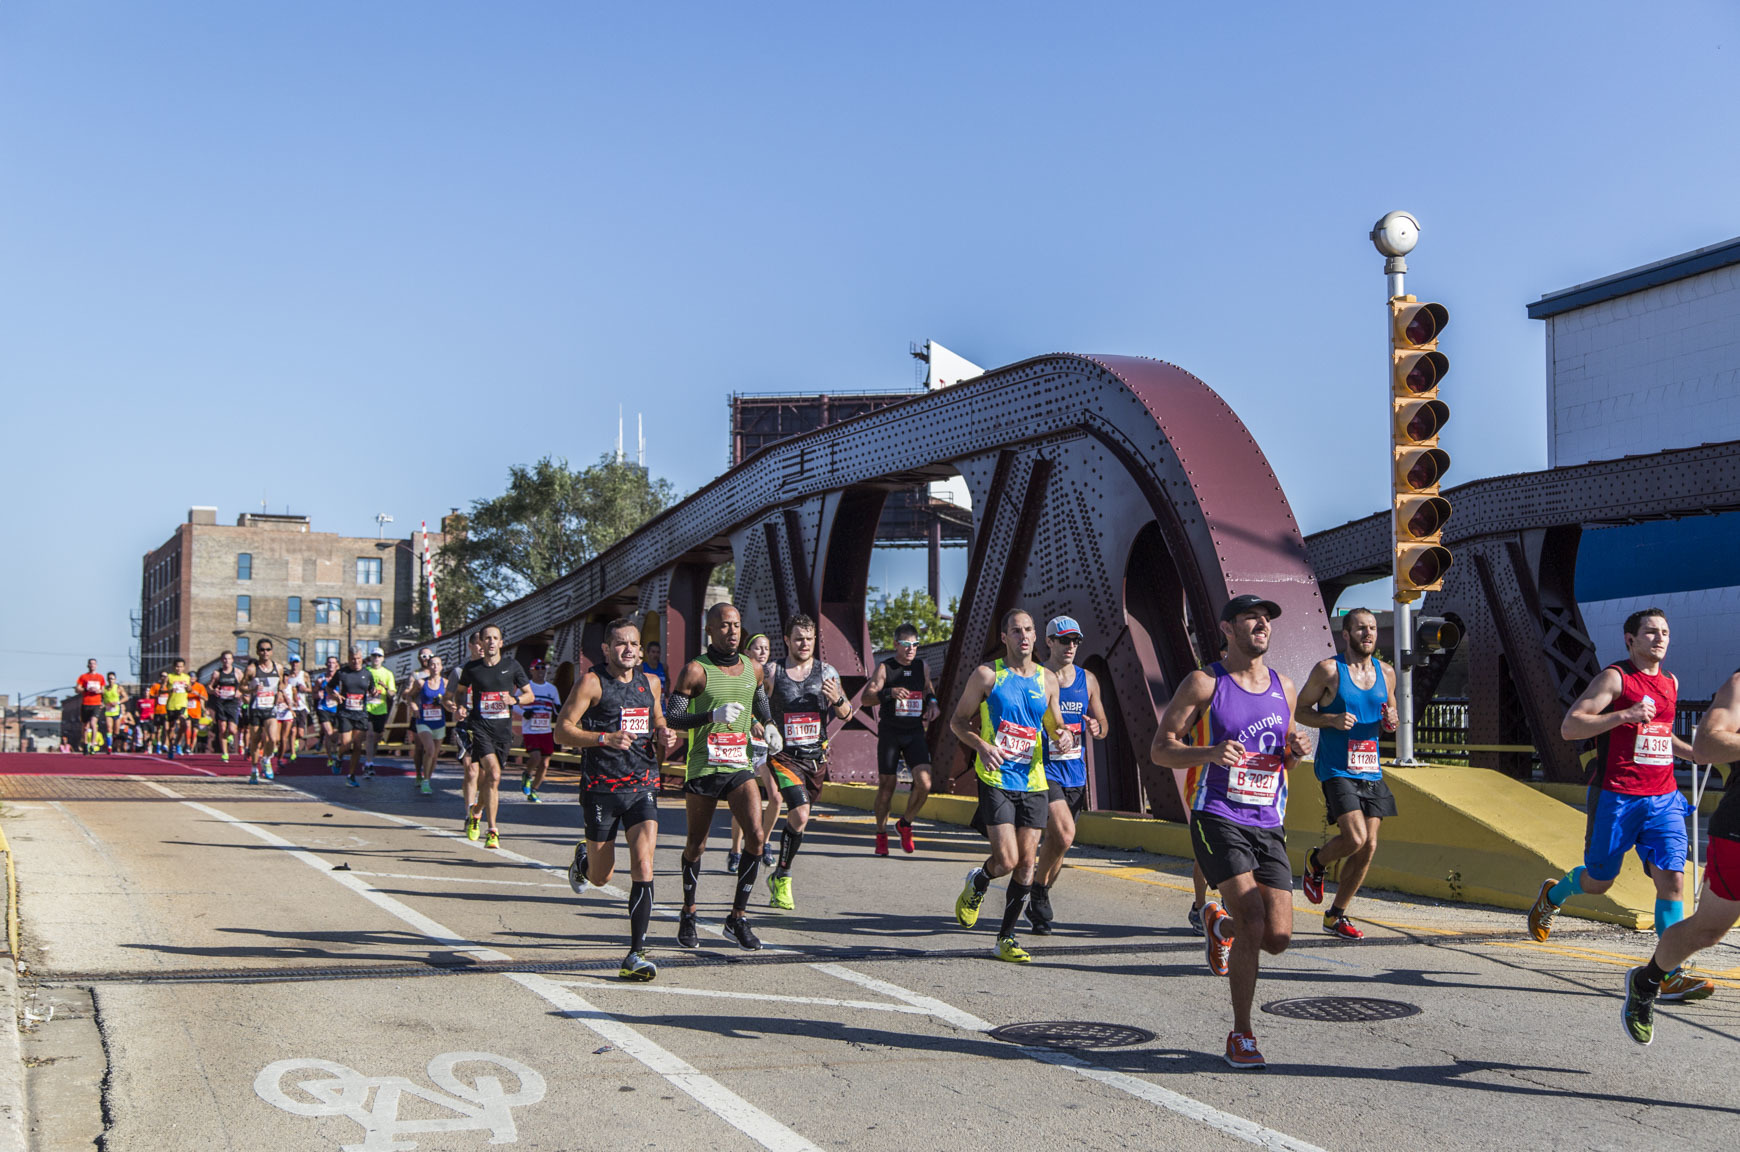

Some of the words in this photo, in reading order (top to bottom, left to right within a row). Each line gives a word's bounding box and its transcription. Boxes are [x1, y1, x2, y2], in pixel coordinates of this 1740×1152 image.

[484, 702, 489, 711] B
[1061, 701, 1083, 712] NBR
[621, 720, 627, 731] B
[629, 719, 649, 731] 2321
[787, 726, 793, 736] B
[795, 724, 817, 736] 11071
[1247, 712, 1283, 737] purple
[1000, 735, 1008, 747] A
[1009, 737, 1031, 753] 3130
[1641, 738, 1649, 751] A
[1351, 753, 1356, 764] B
[1237, 771, 1246, 786] B
[1250, 773, 1275, 789] 7027
